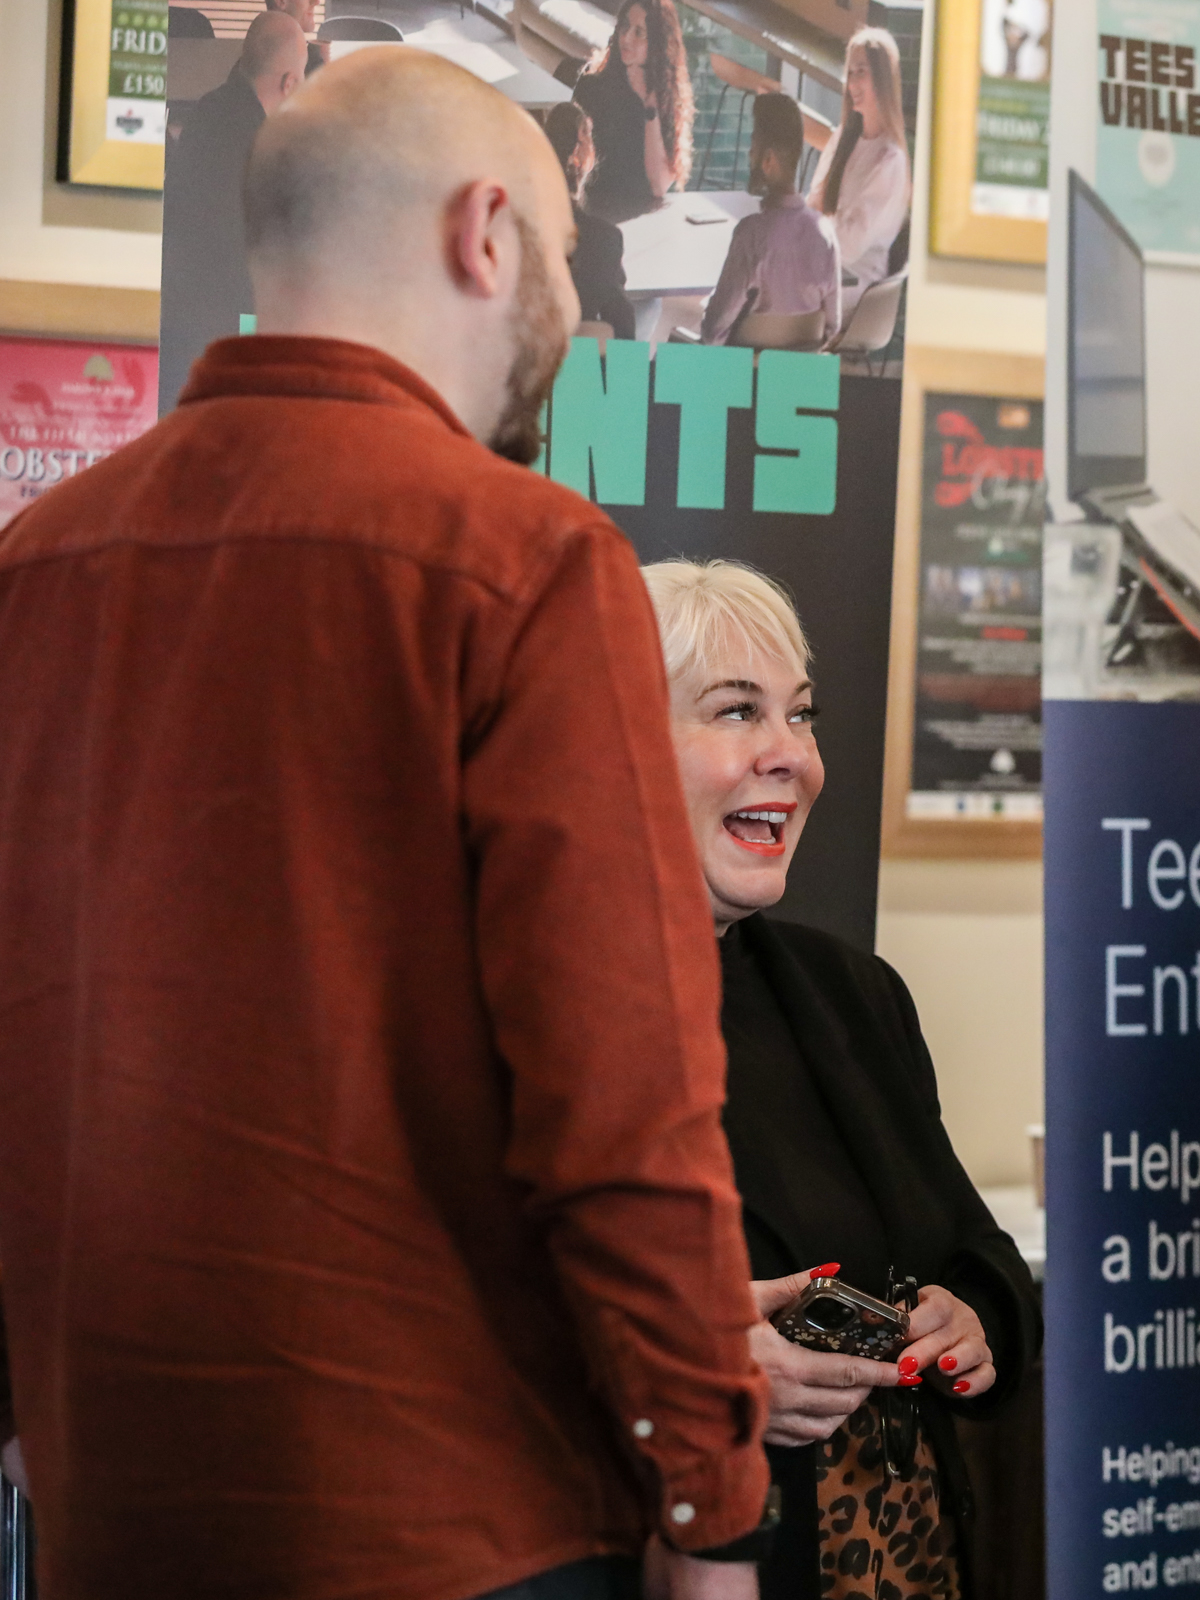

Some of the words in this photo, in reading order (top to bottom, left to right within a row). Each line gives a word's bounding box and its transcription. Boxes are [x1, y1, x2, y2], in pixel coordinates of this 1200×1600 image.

[111, 27, 167, 55] FRID
[1100, 33, 1196, 89] TEES
[530, 335, 840, 516] NTS
[1102, 1234, 1131, 1283] a
[1103, 1551, 1158, 1592] and
